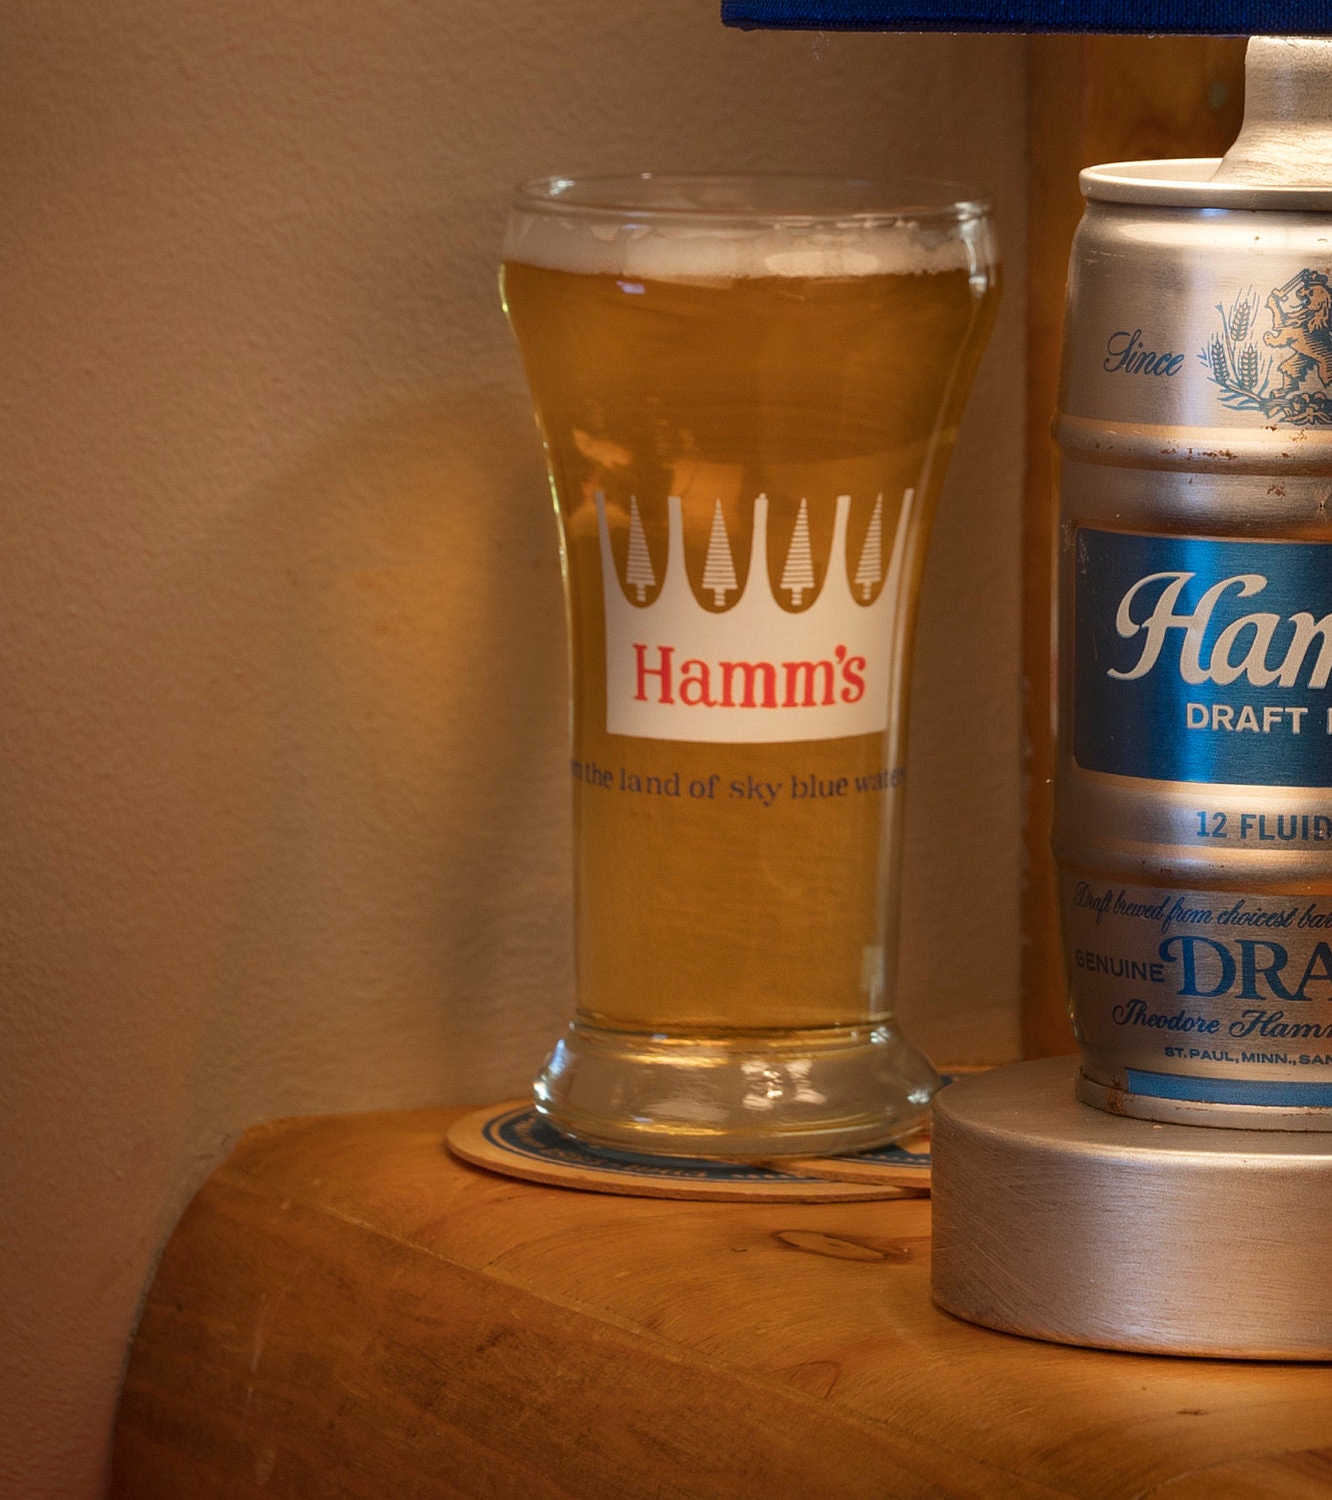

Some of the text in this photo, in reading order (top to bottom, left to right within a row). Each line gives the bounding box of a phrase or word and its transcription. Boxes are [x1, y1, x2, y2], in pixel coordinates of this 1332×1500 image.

[1103, 329, 1185, 377] Since
[632, 643, 867, 709] Hamm's
[1186, 703, 1308, 735] DRAFT
[619, 767, 681, 798] land
[689, 774, 721, 799] of
[729, 776, 783, 808] sky
[790, 774, 848, 799] blue
[1196, 811, 1227, 839] 12
[1112, 895, 1165, 923] brewed
[1161, 897, 1213, 934] from
[1216, 900, 1299, 928] choicest
[1074, 948, 1166, 983] GENUINE
[1112, 1000, 1220, 1034] Theodore
